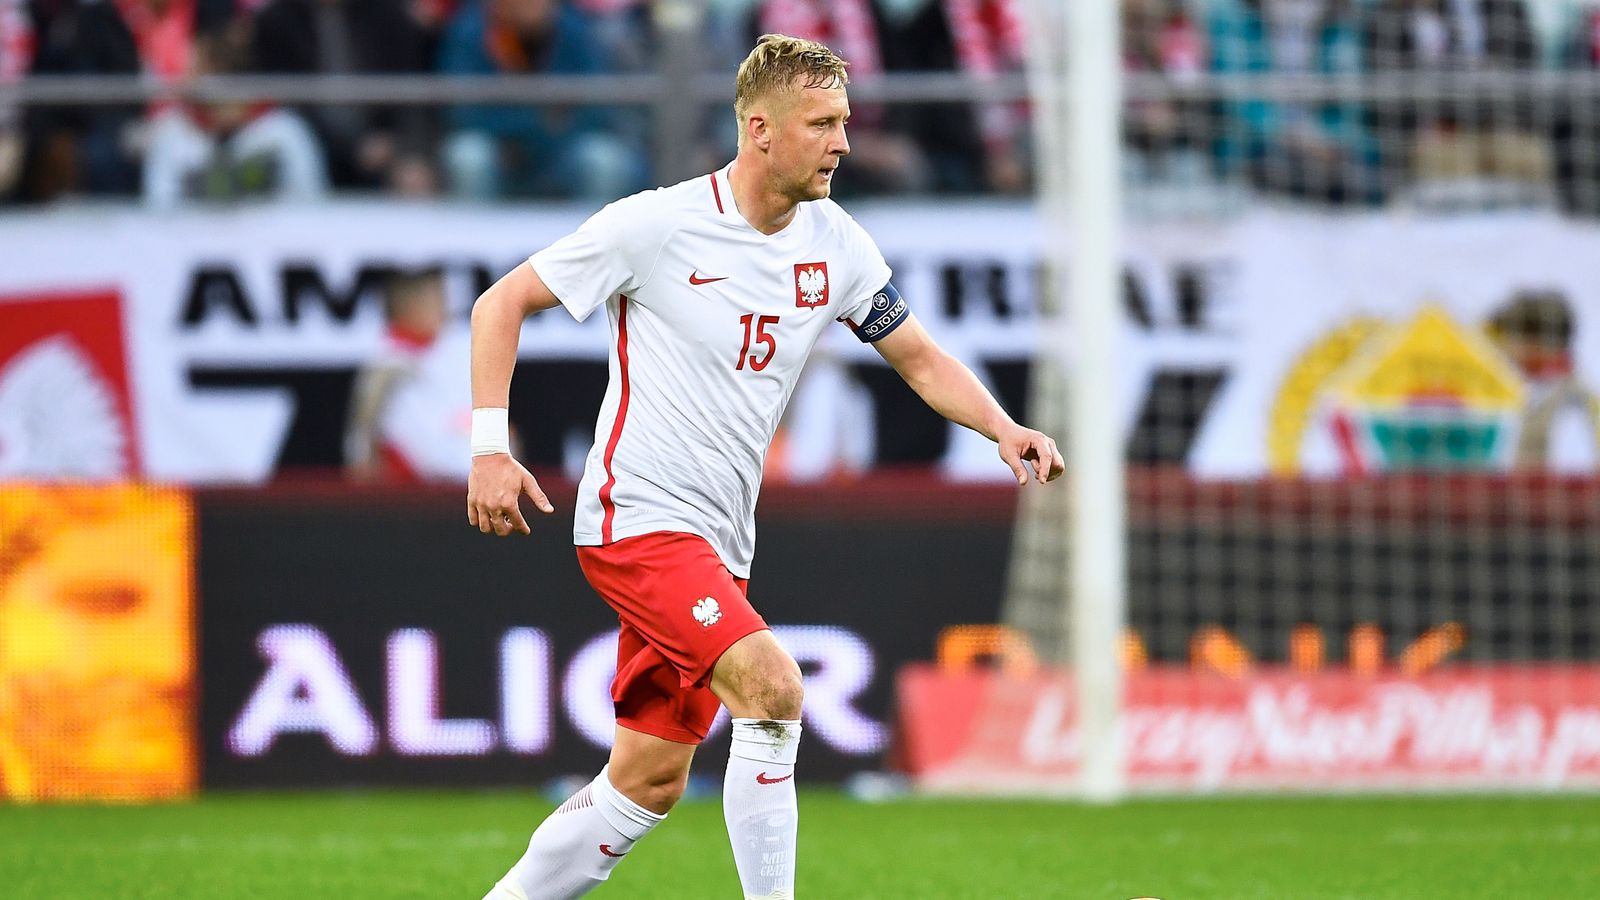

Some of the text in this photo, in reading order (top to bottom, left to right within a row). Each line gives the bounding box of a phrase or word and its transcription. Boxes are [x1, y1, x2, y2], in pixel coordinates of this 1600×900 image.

[735, 313, 780, 371] 15
[864, 325, 878, 336] NO
[877, 316, 891, 328] TO
